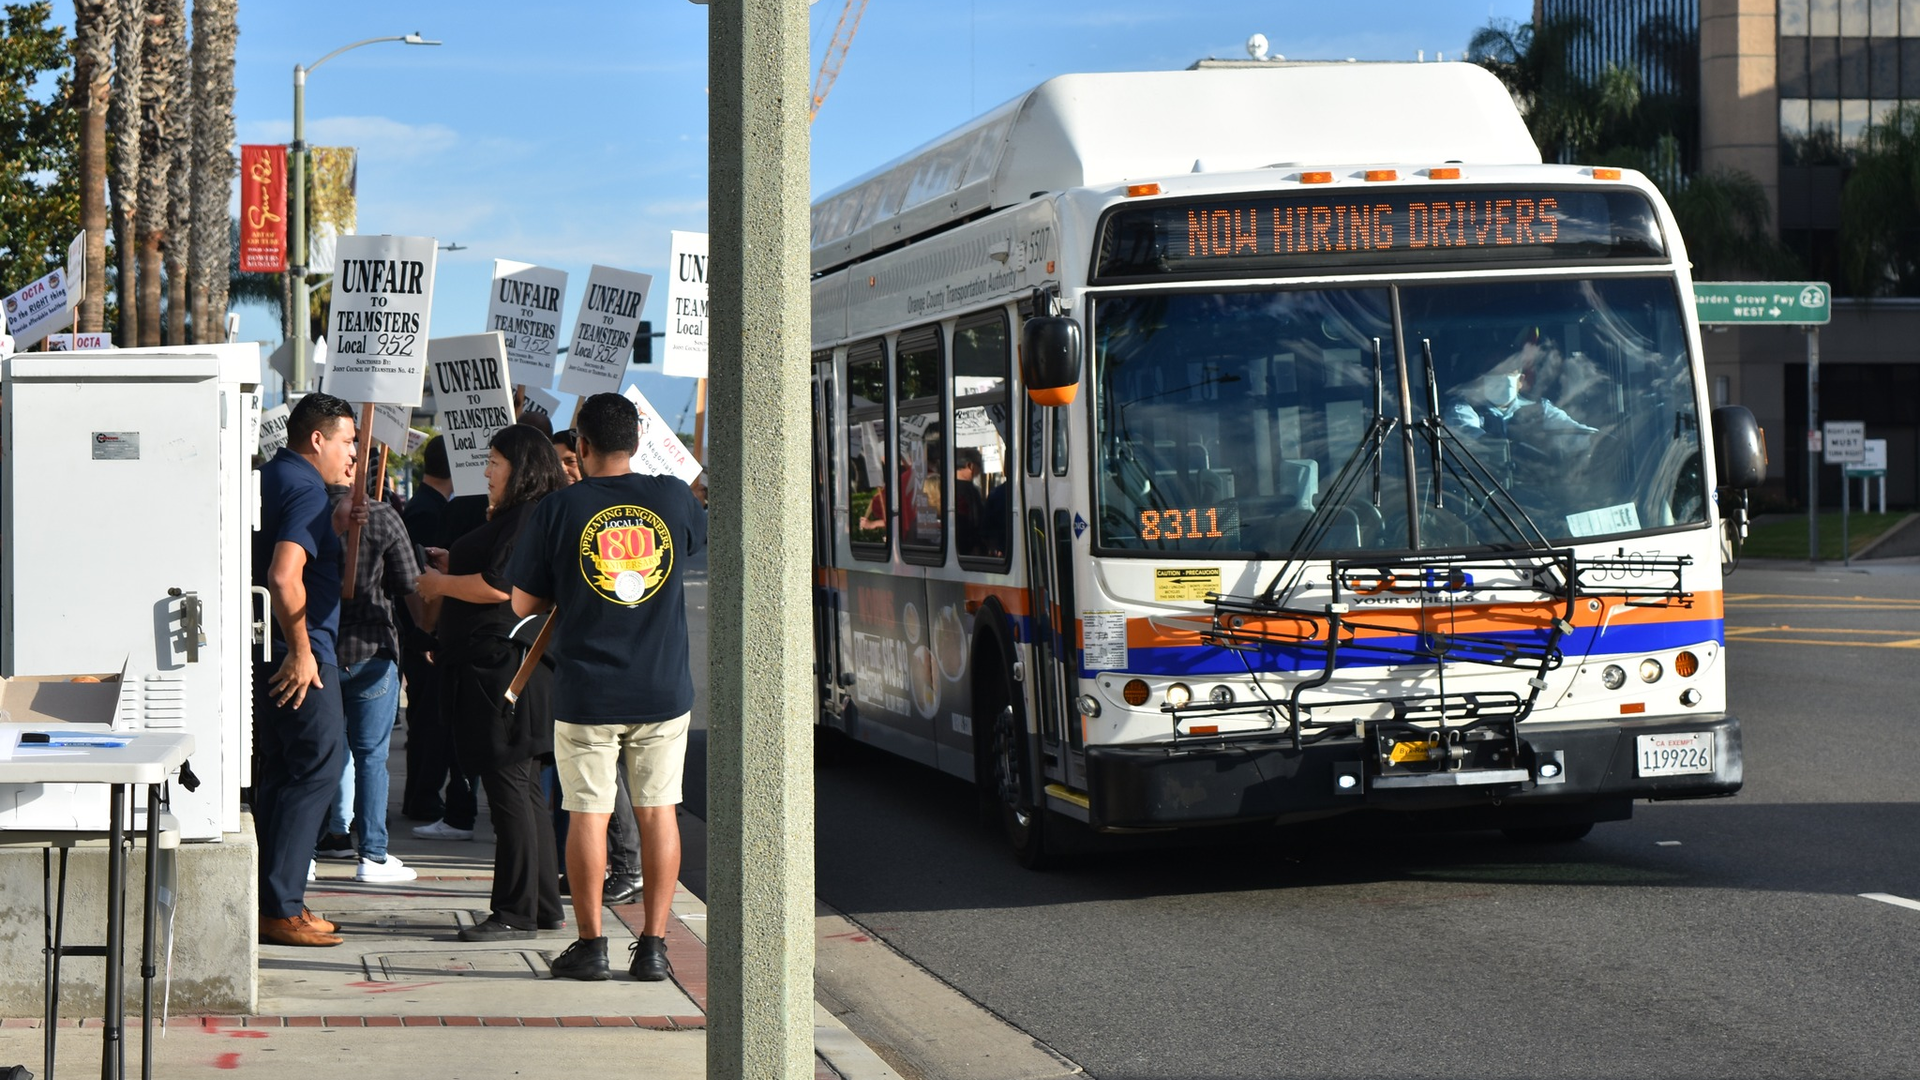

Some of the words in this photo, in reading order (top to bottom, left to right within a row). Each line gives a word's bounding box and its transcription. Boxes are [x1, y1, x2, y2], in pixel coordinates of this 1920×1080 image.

[1188, 207, 1256, 256] NOW
[1273, 204, 1393, 252] HIRING
[1408, 198, 1558, 248] DRIVERS
[1029, 227, 1050, 264] 5507
[342, 260, 424, 294] UNFAIR
[22, 282, 45, 301] OCTA
[370, 297, 387, 307] TO
[500, 278, 559, 312] UNFAIR
[588, 284, 641, 318] UNFAIR
[908, 296, 925, 315] Orange
[926, 291, 945, 310] County
[946, 277, 986, 306] Transportation
[988, 269, 1017, 291] Authority
[1736, 295, 1767, 304] Grove
[1773, 295, 1794, 306] Fwy
[1804, 292, 1821, 304] 22
[8, 316, 17, 325] Do
[18, 310, 28, 319] the
[29, 296, 49, 313] RIGHT
[50, 289, 66, 300] thing
[521, 309, 533, 317] TO
[1734, 307, 1764, 317] WEST
[337, 311, 419, 333] TEAMSTERS
[495, 315, 555, 340] TEAMSTERS
[603, 316, 614, 325] TO
[677, 318, 702, 335] Local
[77, 337, 100, 347] OCTA
[337, 335, 366, 353] Local
[378, 333, 415, 356] 952
[505, 335, 517, 348] cal
[521, 336, 551, 354] 952
[578, 323, 630, 348] TEAMSTERS
[574, 342, 595, 359] Local
[435, 357, 501, 394] UNFAIR
[467, 394, 480, 405] TO
[444, 406, 508, 430] TEAMSTERS
[451, 431, 476, 450] Local
[641, 453, 657, 473] Good
[663, 438, 685, 466] OCTA
[582, 509, 622, 555] OPERATING
[625, 508, 670, 549] ENGINEERS
[605, 519, 634, 528] LOCAL
[1140, 508, 1222, 540] 8311
[607, 528, 645, 560] 80
[597, 556, 659, 569] ANNIVERSARY
[1592, 550, 1660, 581] 5507
[1405, 595, 1474, 603] WHEELS
[1644, 748, 1707, 769] 1199226
